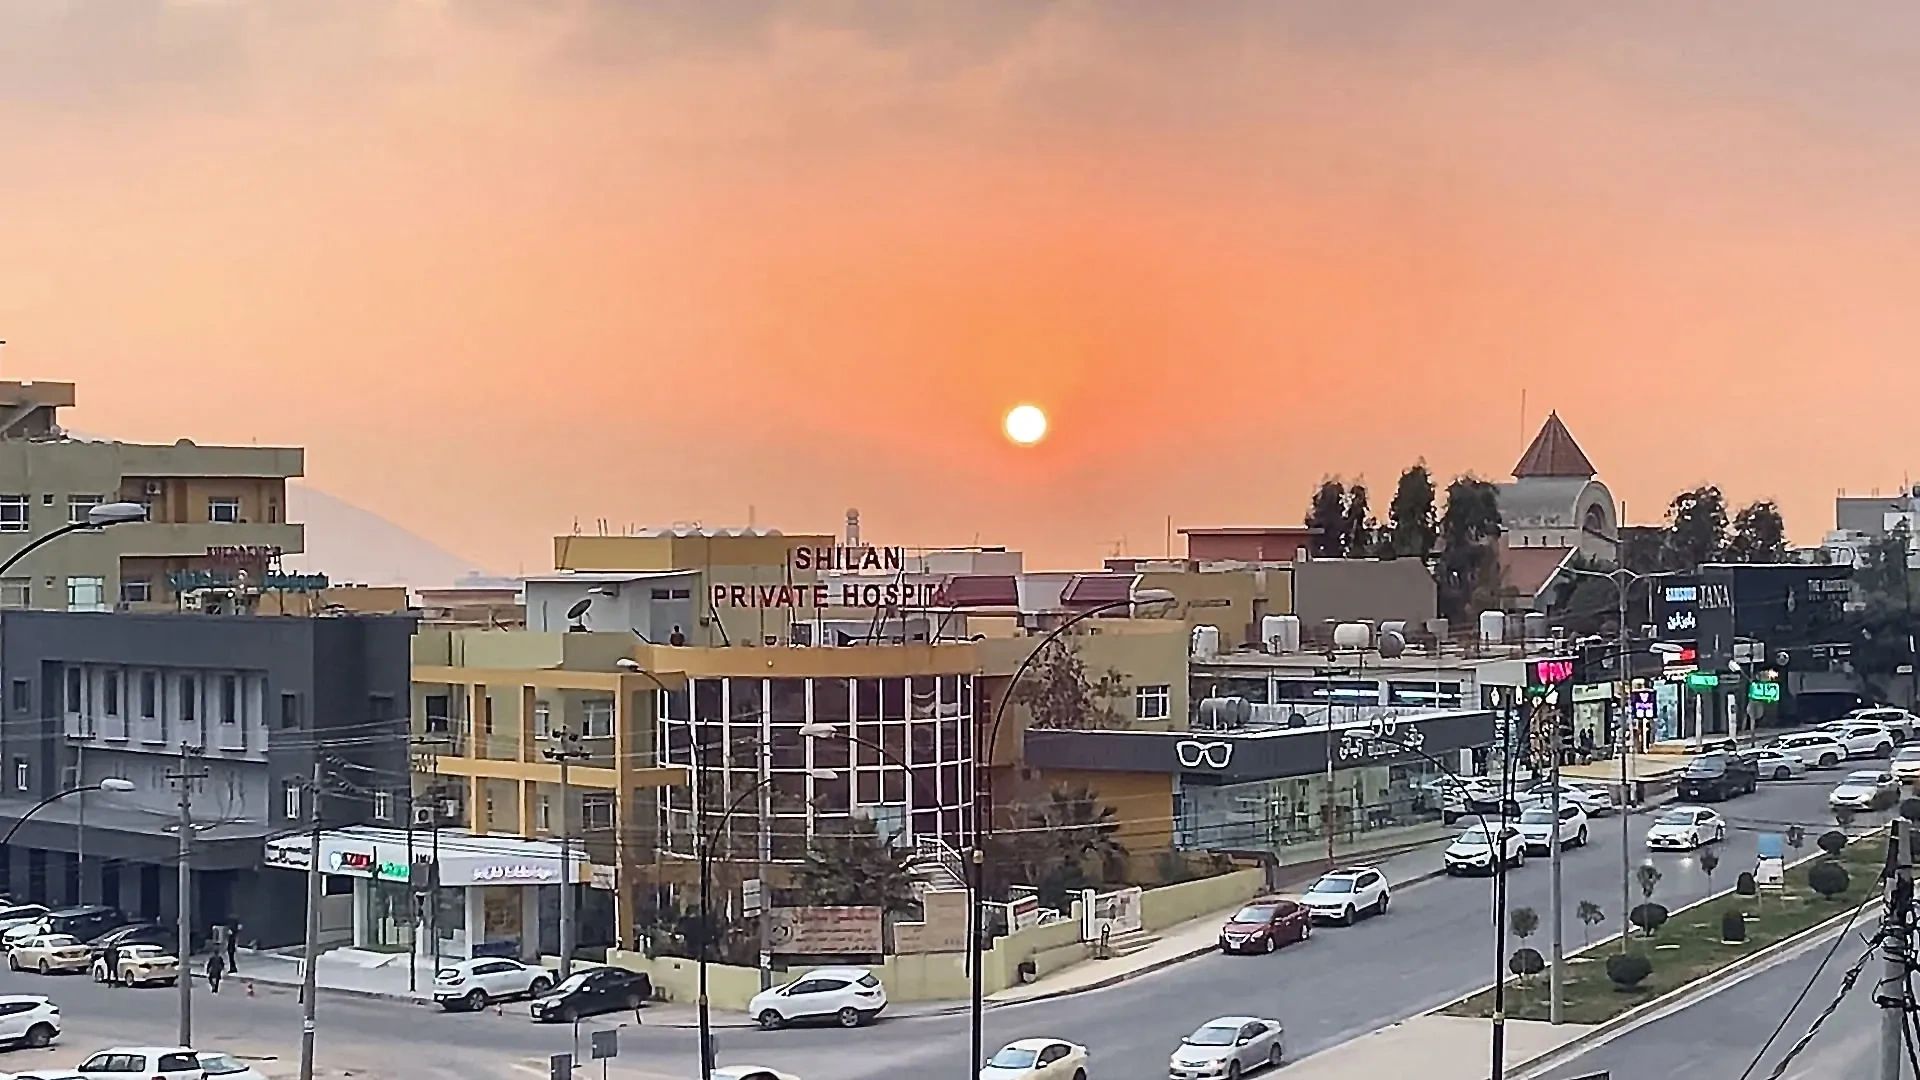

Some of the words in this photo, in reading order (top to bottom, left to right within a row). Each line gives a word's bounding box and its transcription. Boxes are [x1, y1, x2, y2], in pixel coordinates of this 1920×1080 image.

[795, 546, 901, 571] SHILAN
[713, 584, 829, 609] PRIVATE
[1698, 584, 1730, 609] JANA
